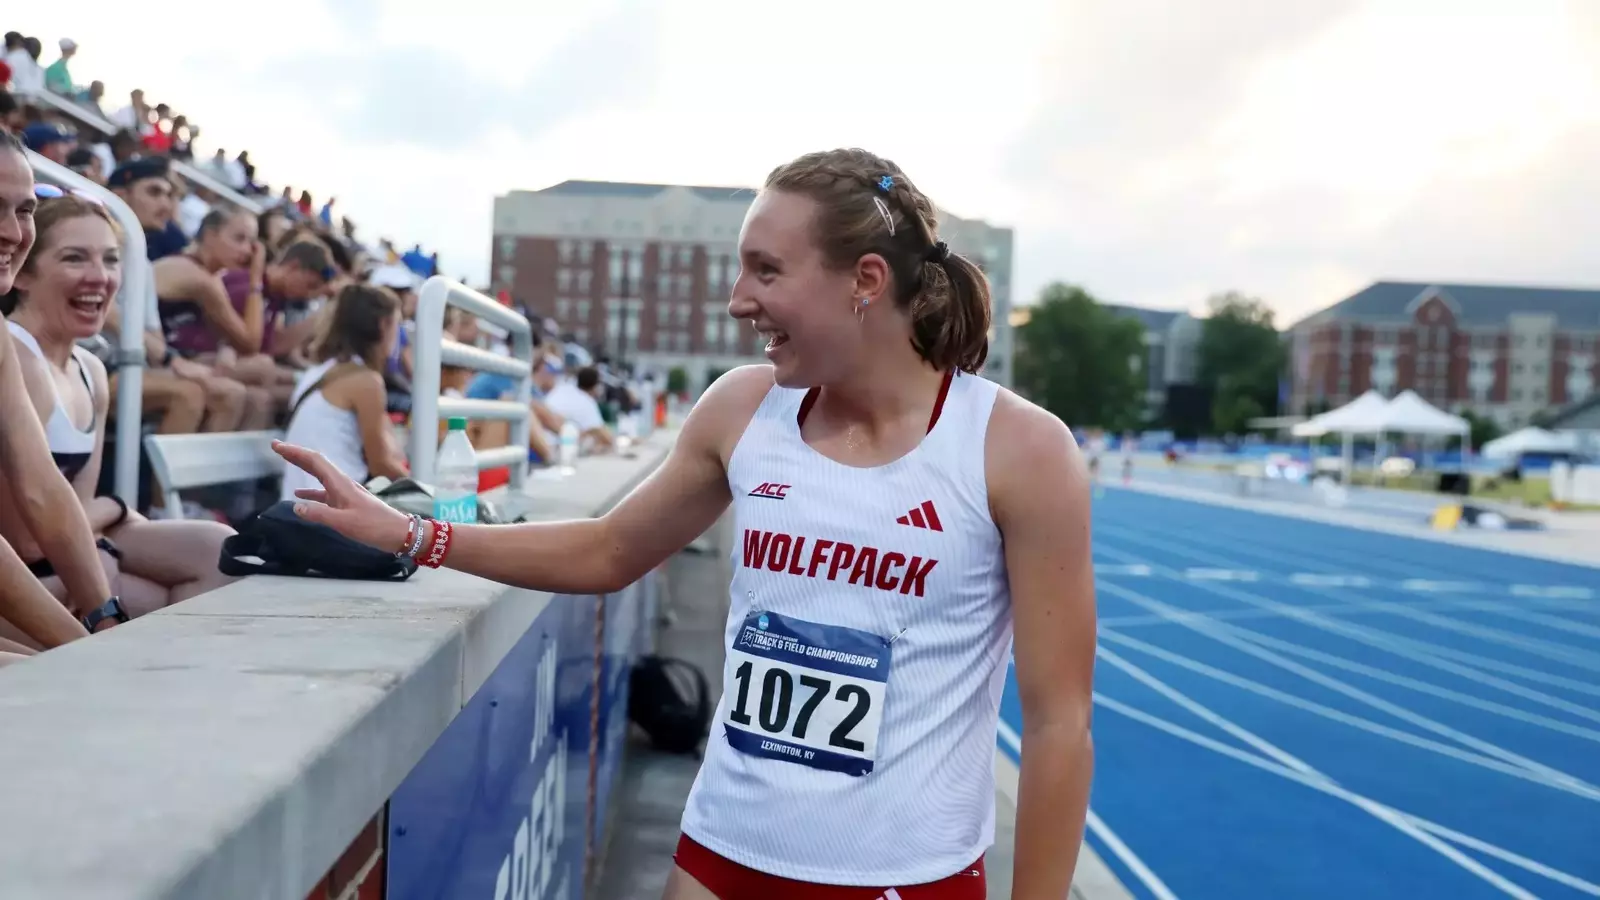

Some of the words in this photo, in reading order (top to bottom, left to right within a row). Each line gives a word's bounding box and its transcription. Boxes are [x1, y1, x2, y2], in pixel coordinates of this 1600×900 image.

[752, 482, 792, 497] ACC
[743, 529, 939, 598] WOLFPACK
[754, 634, 777, 648] TRACK
[784, 642, 805, 654] FIELD
[806, 647, 878, 668] CHAMPIONSHIPS
[730, 661, 871, 752] 1072
[761, 740, 802, 757] LEXINGTON,
[803, 750, 815, 760] KY
